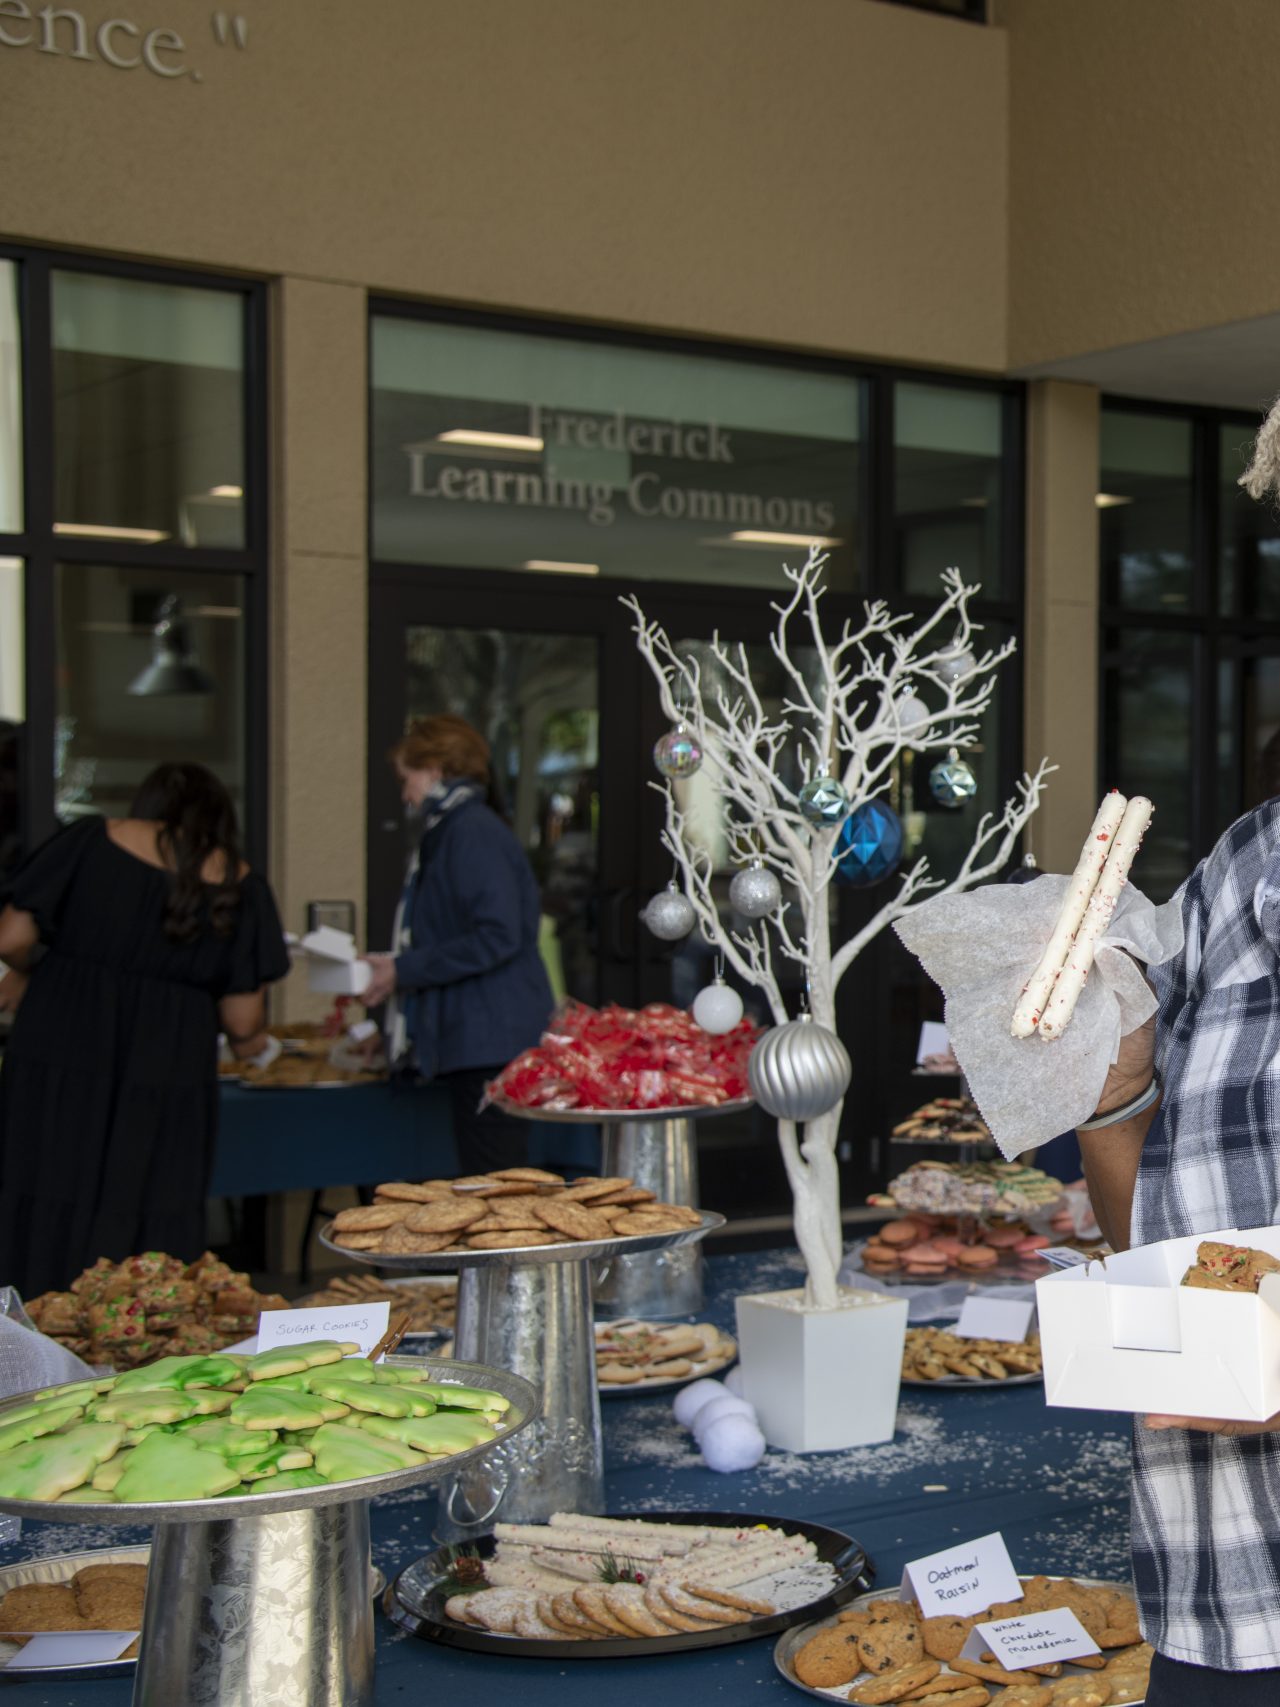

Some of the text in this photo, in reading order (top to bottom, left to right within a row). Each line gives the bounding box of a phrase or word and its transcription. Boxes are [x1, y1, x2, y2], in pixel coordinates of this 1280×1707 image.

[529, 403, 735, 464] Frederick
[409, 452, 836, 532] Learning Commons
[927, 1555, 980, 1584] Oatmeal
